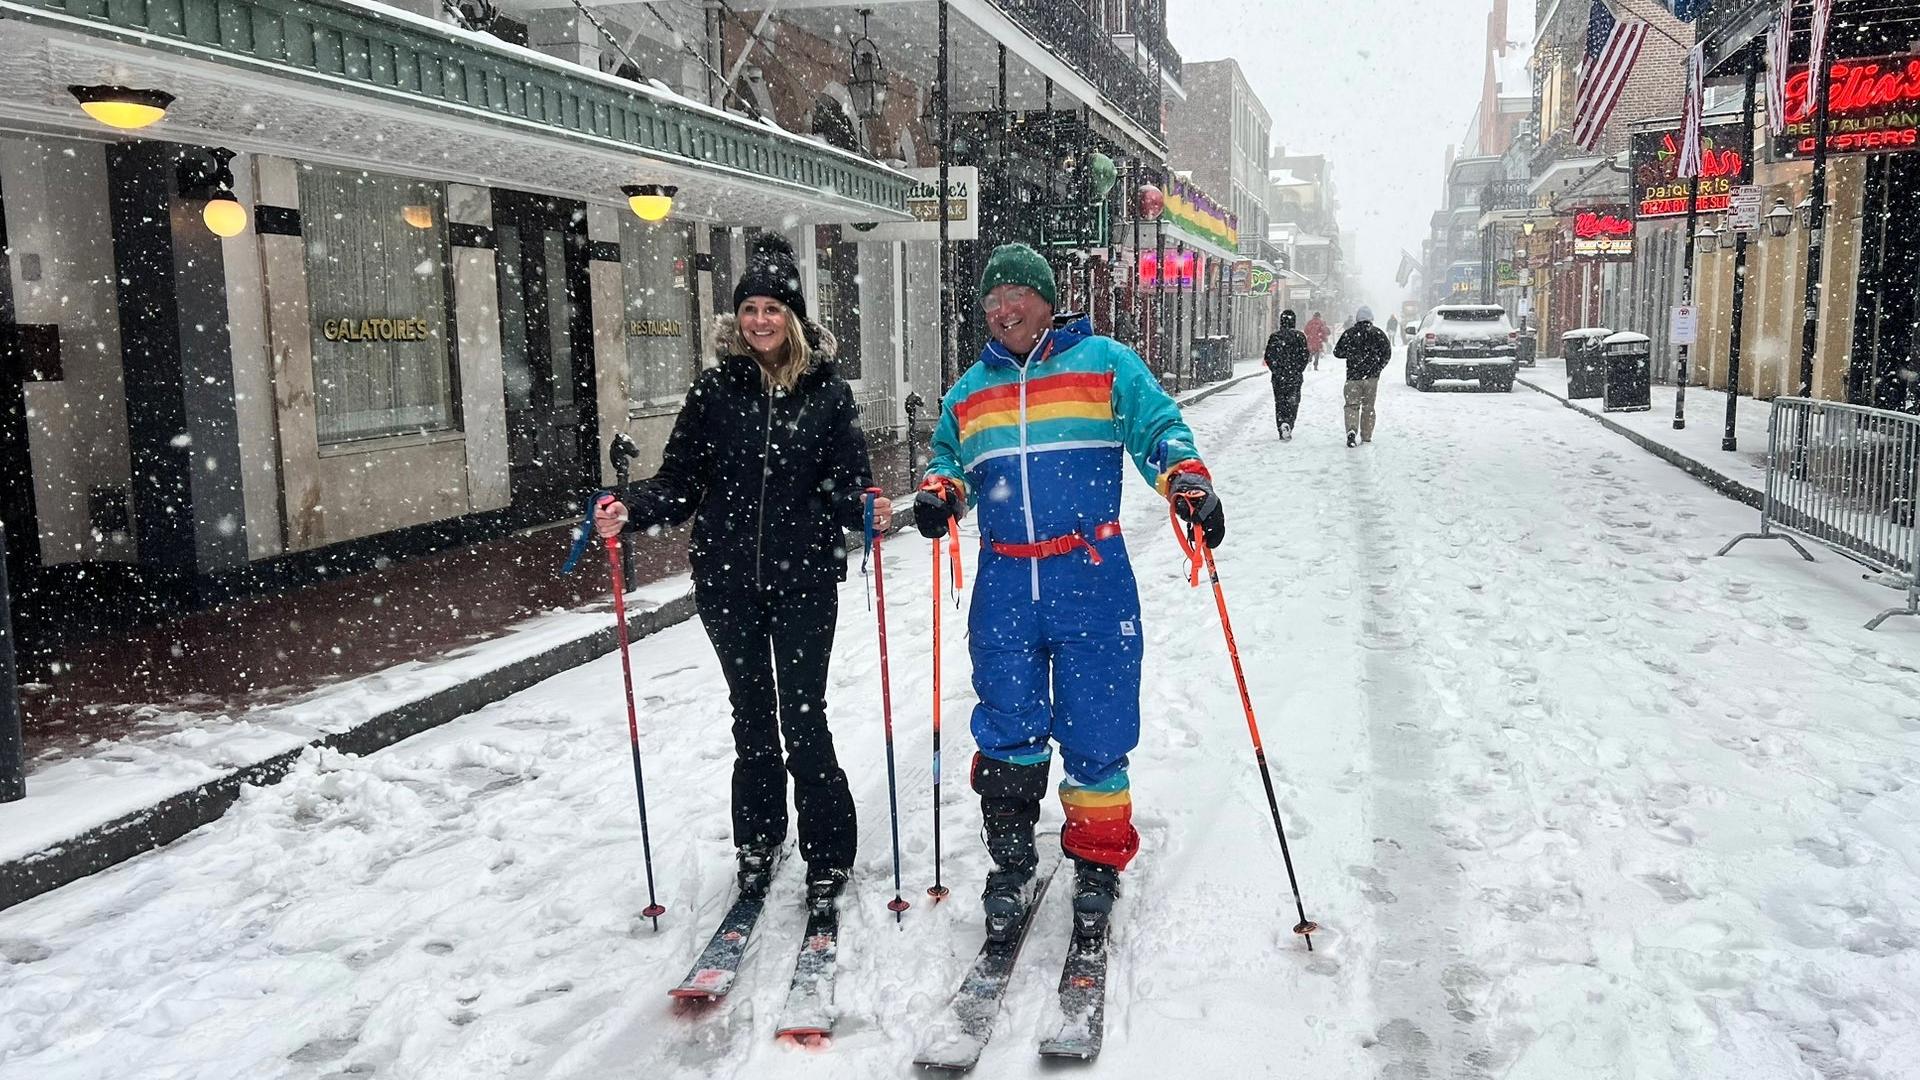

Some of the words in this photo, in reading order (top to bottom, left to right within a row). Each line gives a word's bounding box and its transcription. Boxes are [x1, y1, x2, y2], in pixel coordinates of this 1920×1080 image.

[1787, 113, 1918, 135] RETAURAN
[925, 204, 963, 217] STAK
[1643, 201, 1671, 214] PIZZA
[1673, 200, 1687, 212] BY
[1696, 197, 1709, 209] HE
[630, 320, 682, 337] RESTAURANT
